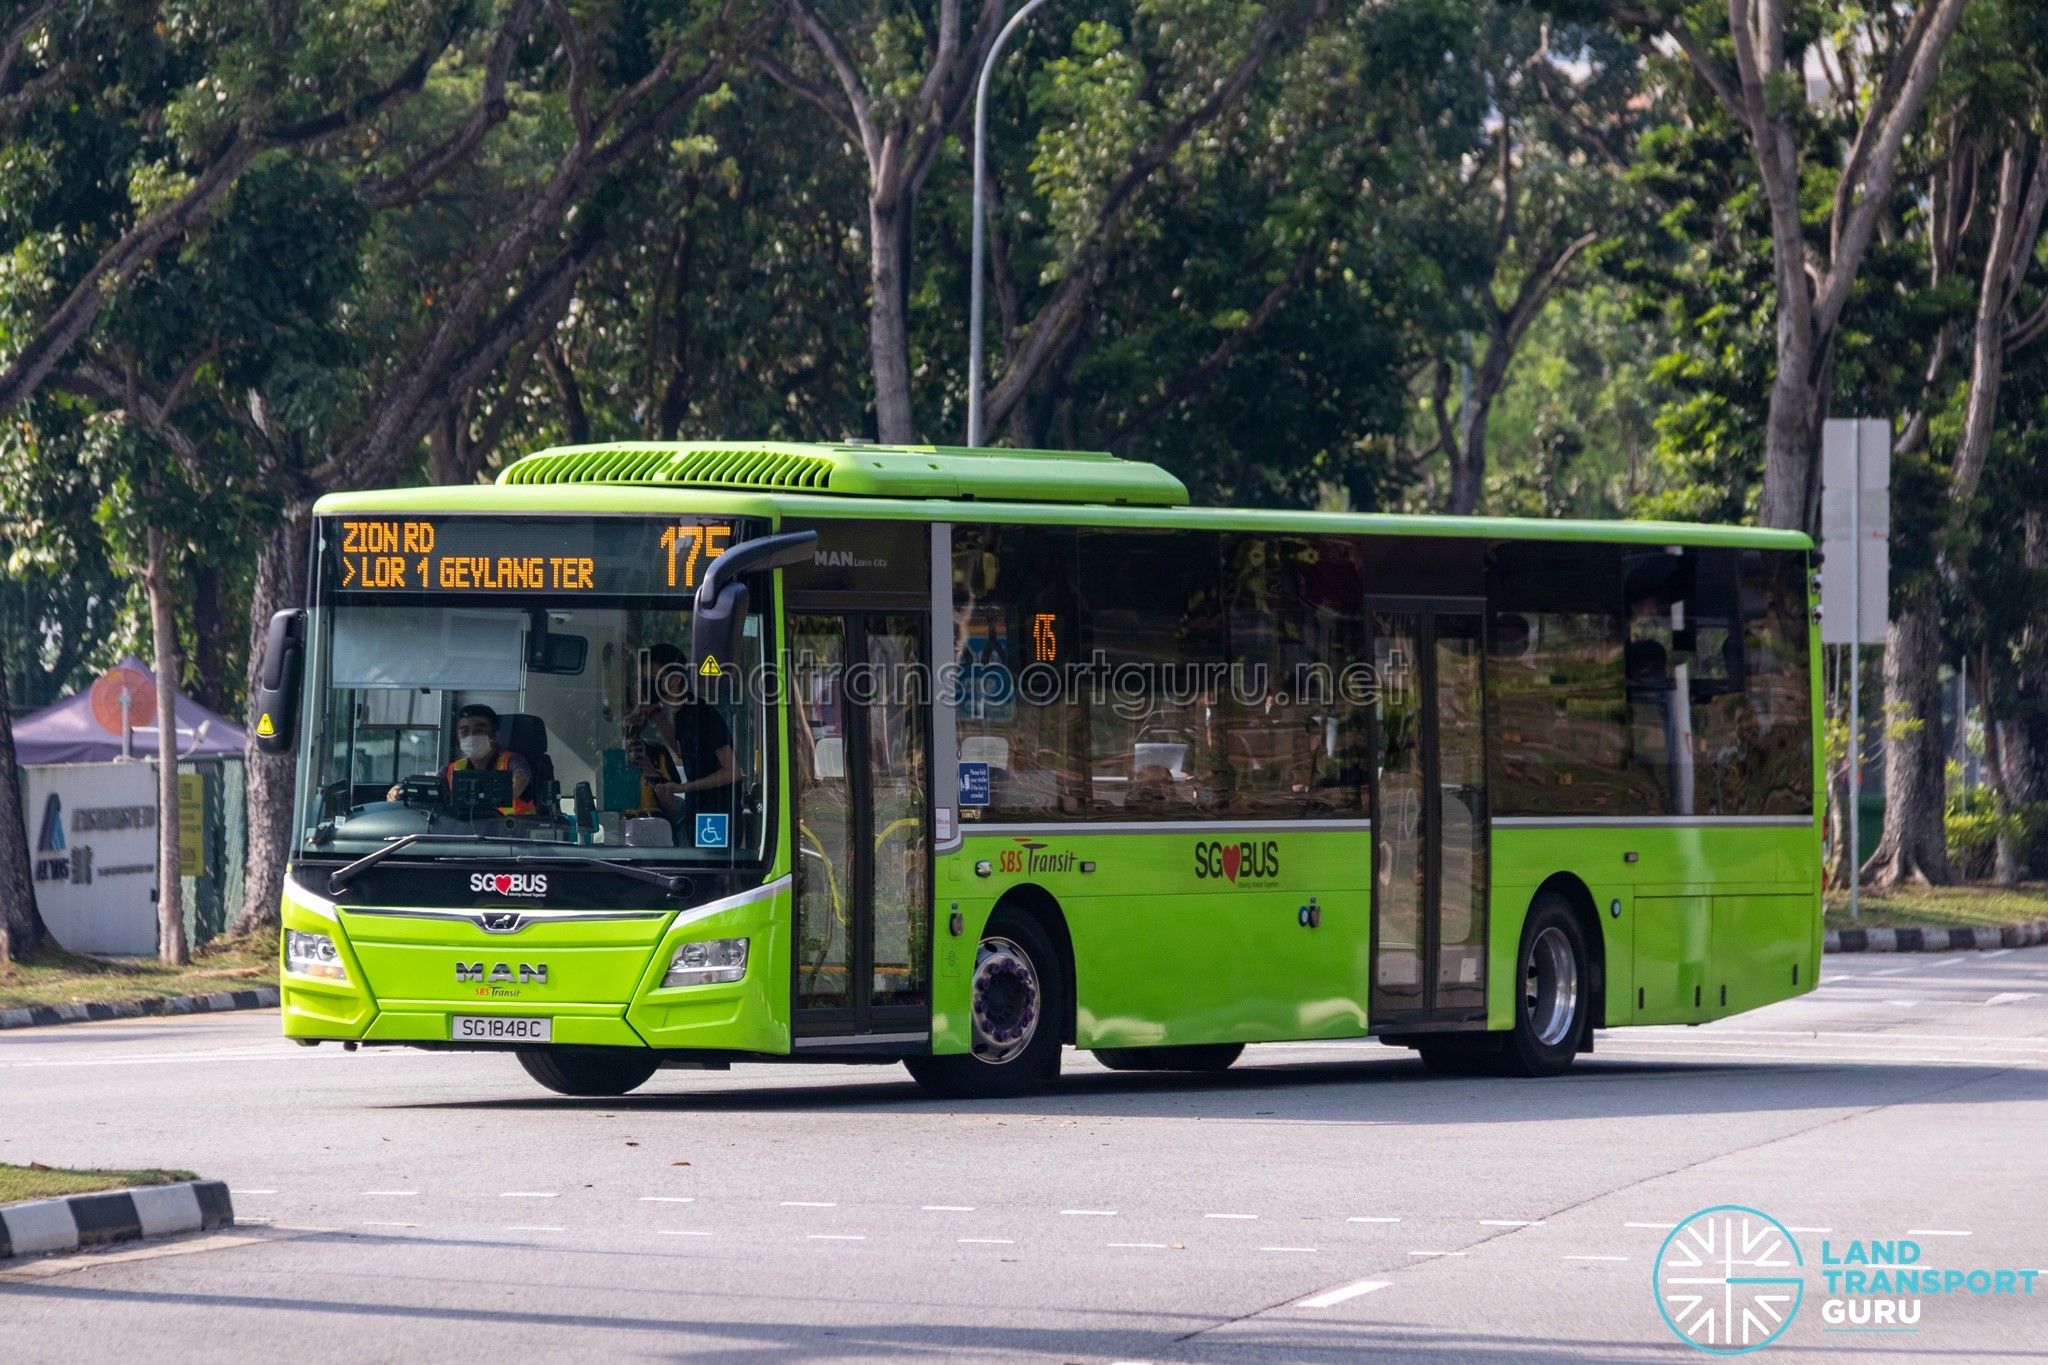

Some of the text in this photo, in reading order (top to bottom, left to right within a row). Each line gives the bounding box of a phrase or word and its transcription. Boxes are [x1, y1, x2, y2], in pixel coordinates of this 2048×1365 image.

[342, 522, 435, 553] ZION RD
[814, 550, 853, 567] MAN
[361, 557, 594, 588] LOR 1 GEYLANG TER
[1033, 614, 1056, 661] 175
[999, 843, 1078, 877] SBS Transit
[456, 962, 547, 984] MAN
[475, 986, 521, 997] SBS Transit
[462, 1019, 541, 1037] SG1848C
